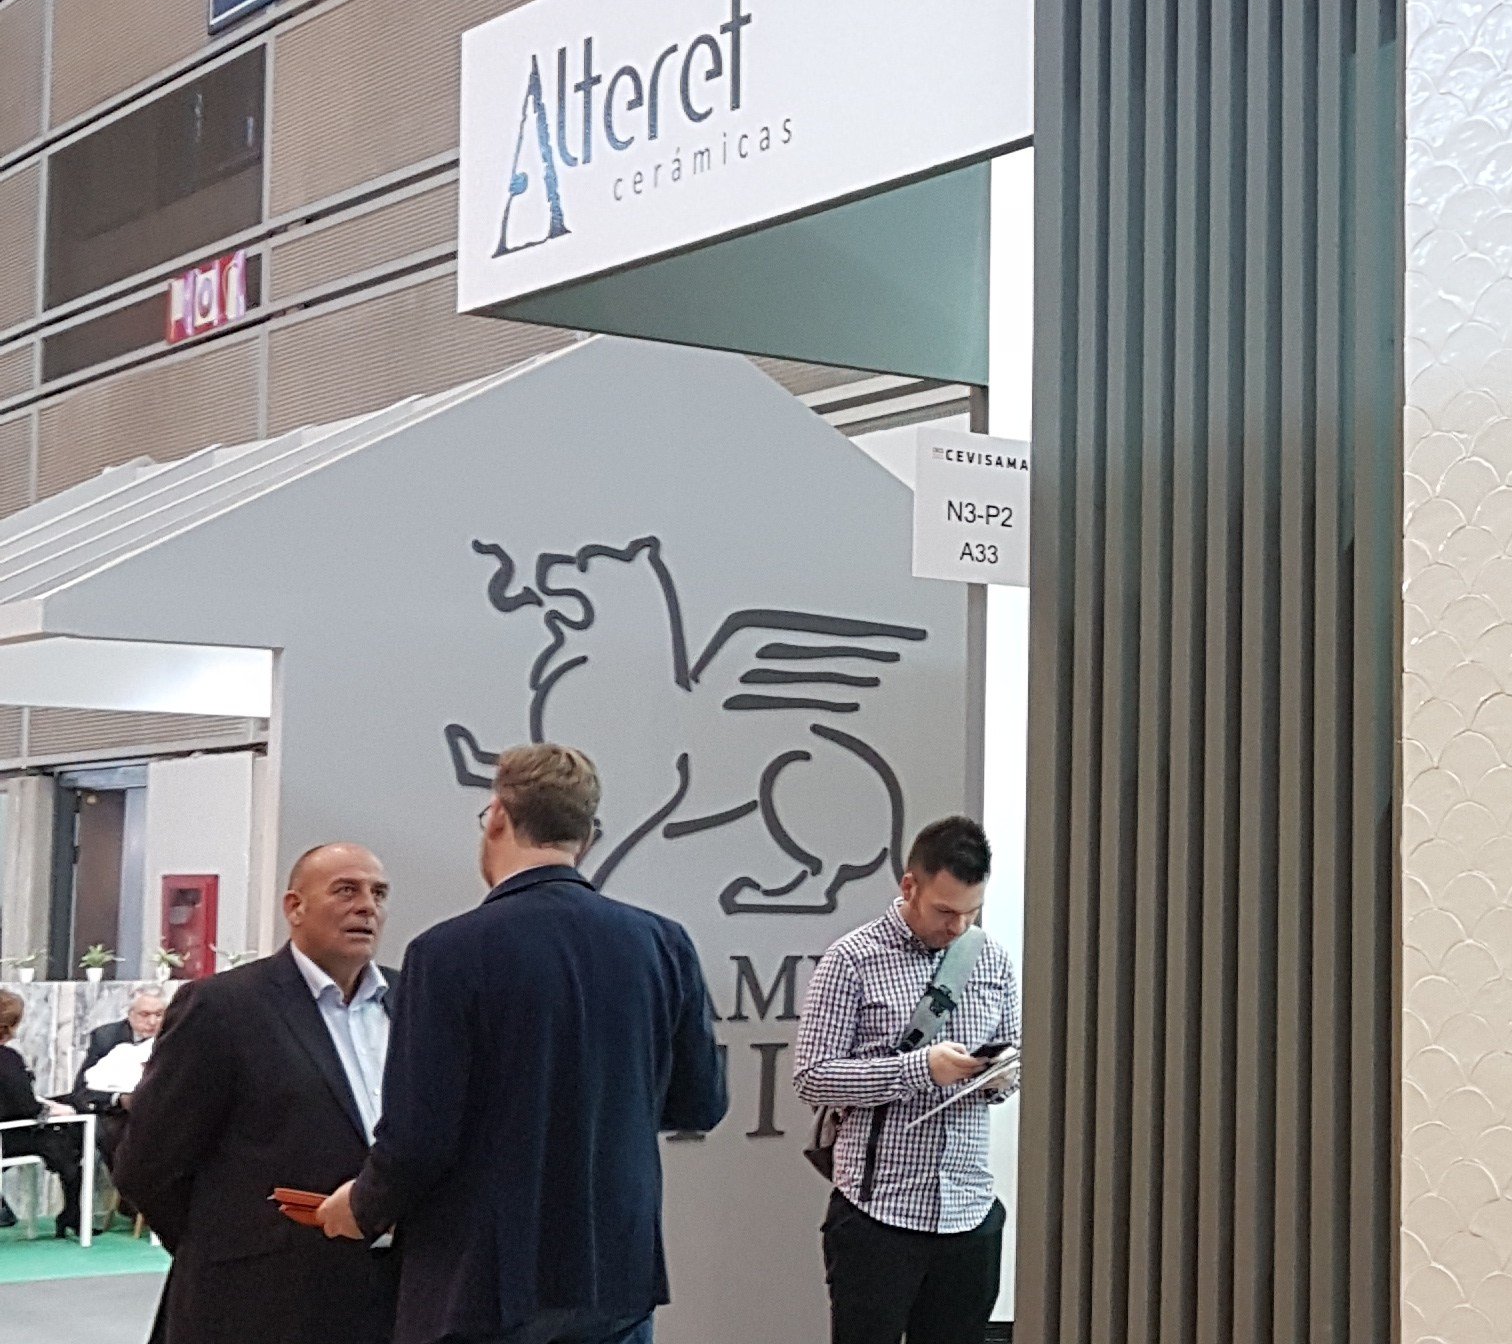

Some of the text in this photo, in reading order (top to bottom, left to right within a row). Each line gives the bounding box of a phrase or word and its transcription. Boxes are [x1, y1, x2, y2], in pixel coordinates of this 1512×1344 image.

[612, 116, 794, 202] cerámicas
[945, 448, 1029, 471] CEVISAMA
[946, 499, 1014, 529] N3-P2
[959, 541, 999, 565] A33
